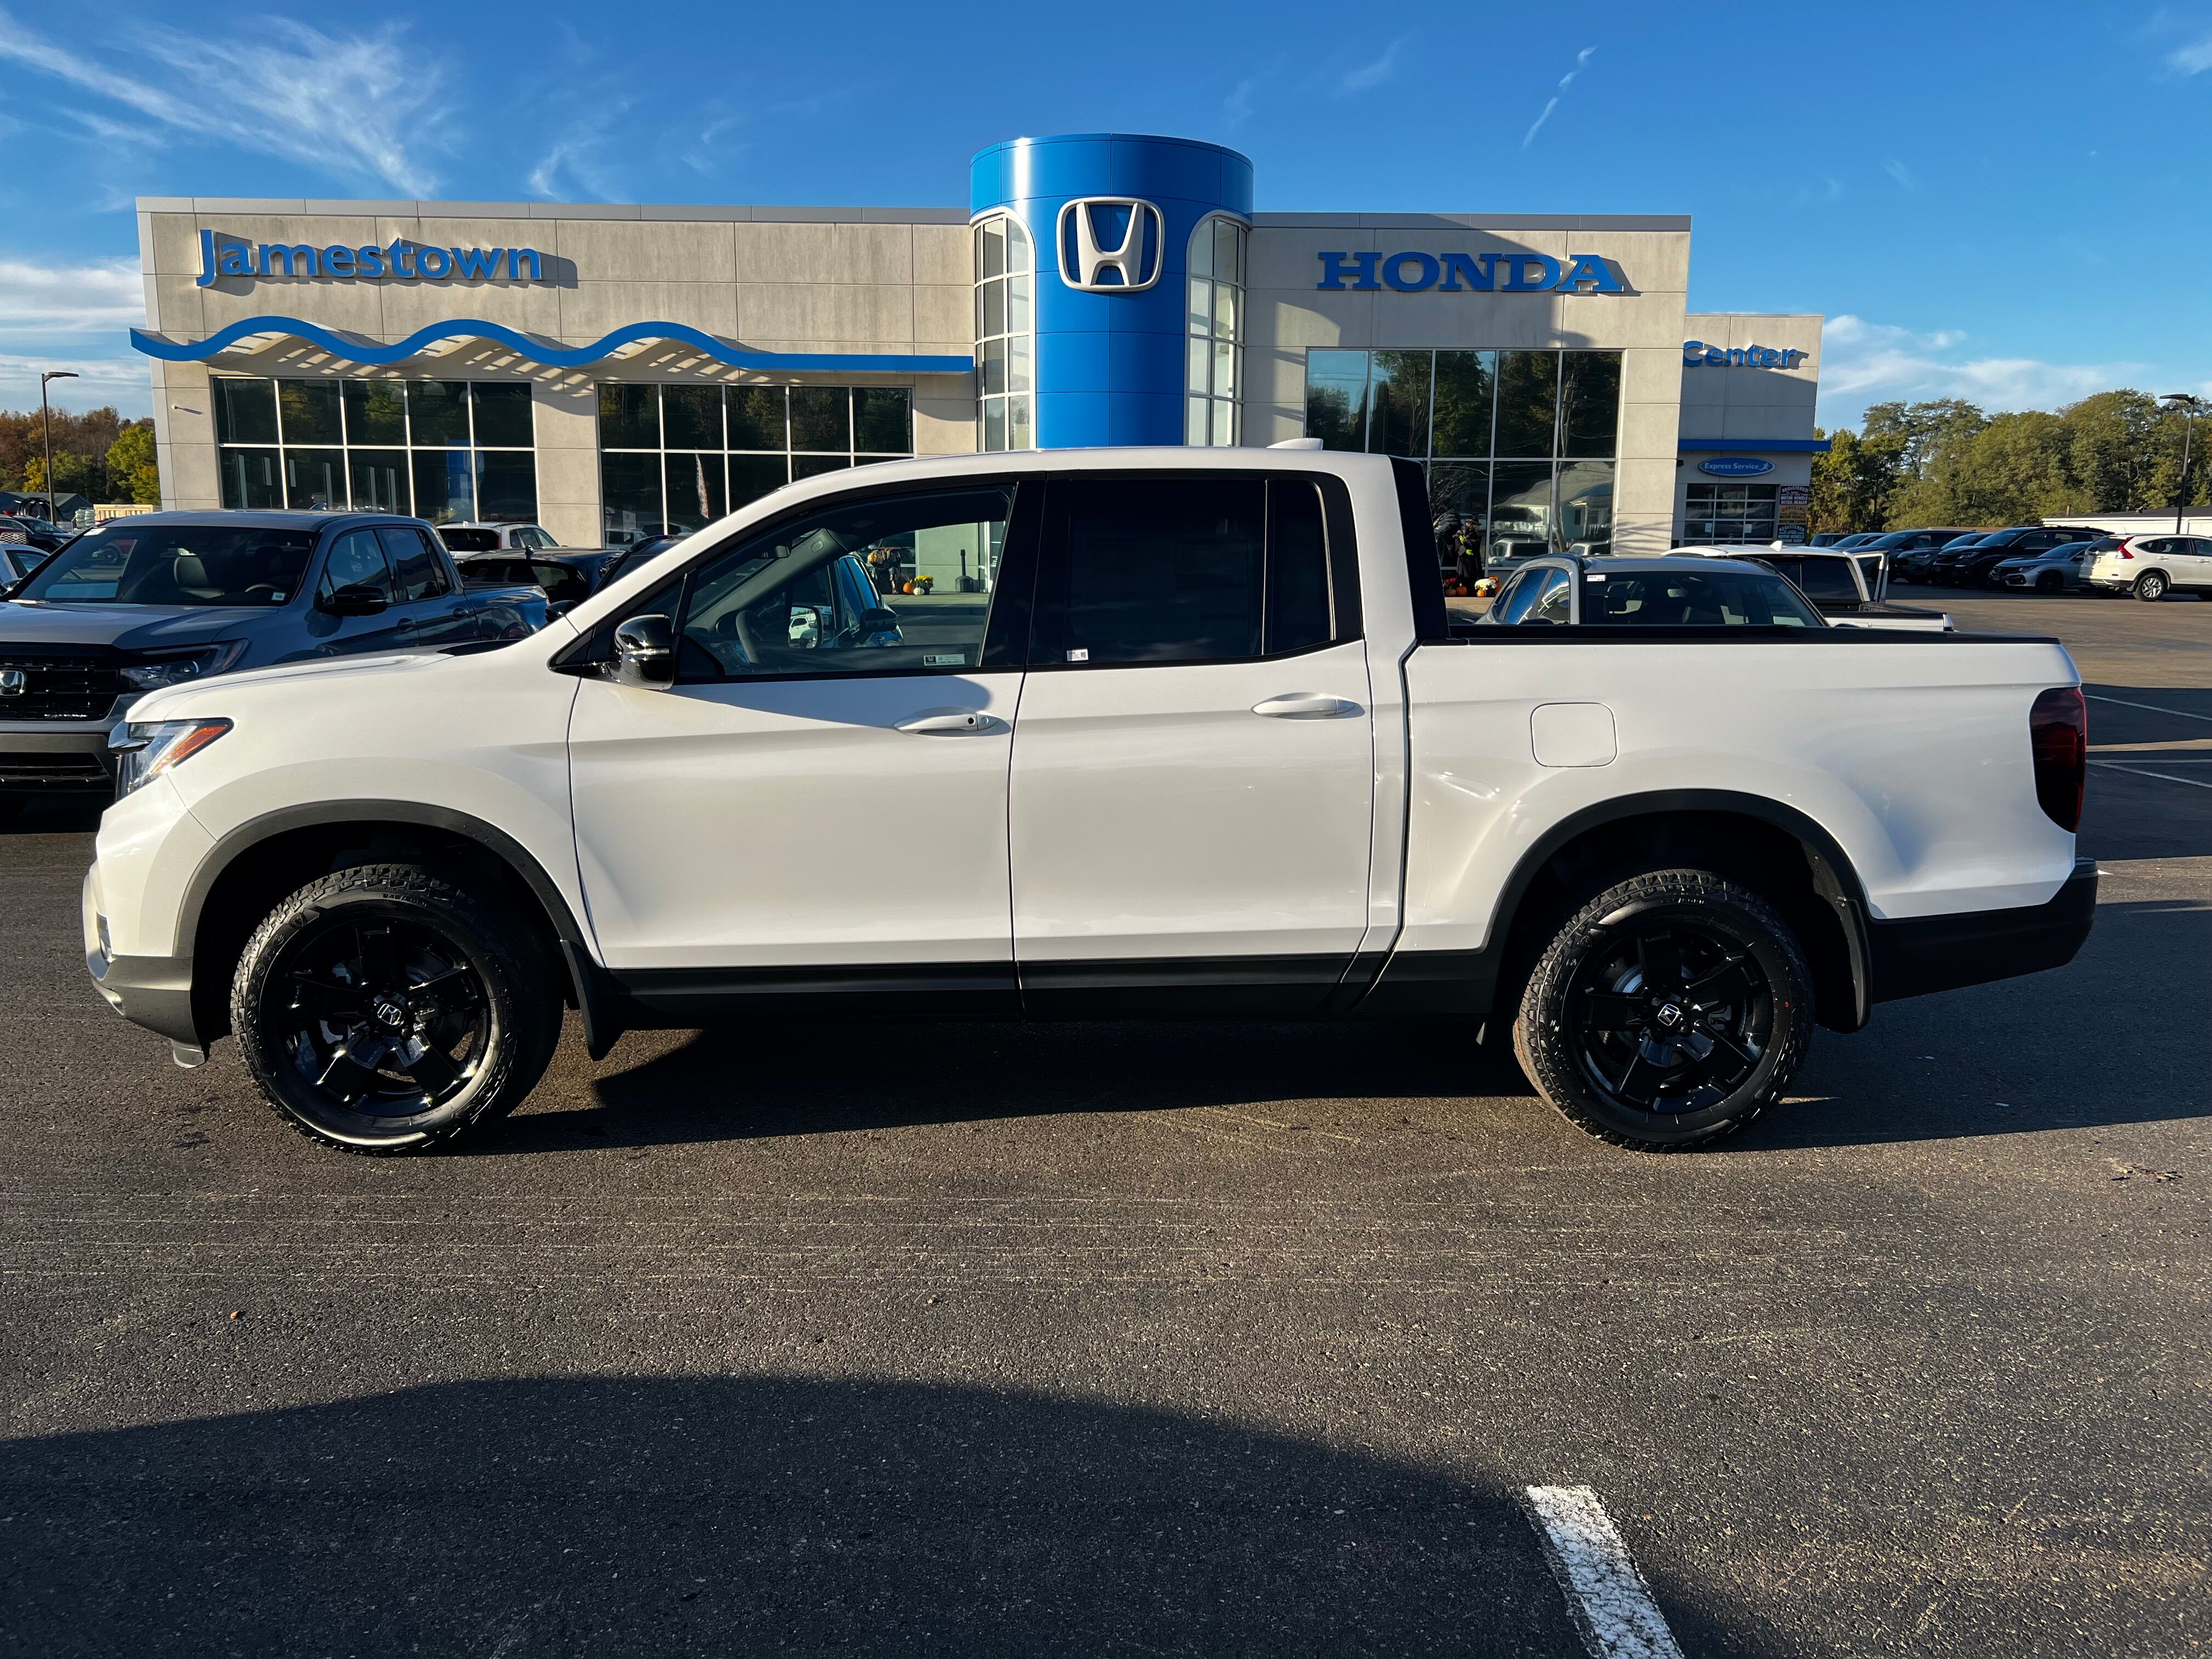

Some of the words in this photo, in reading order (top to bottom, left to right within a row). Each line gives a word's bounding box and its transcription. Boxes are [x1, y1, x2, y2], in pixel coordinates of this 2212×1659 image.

[196, 229, 544, 288] Jamestown
[1317, 251, 1624, 292] HONDA
[1683, 340, 1797, 367] Center
